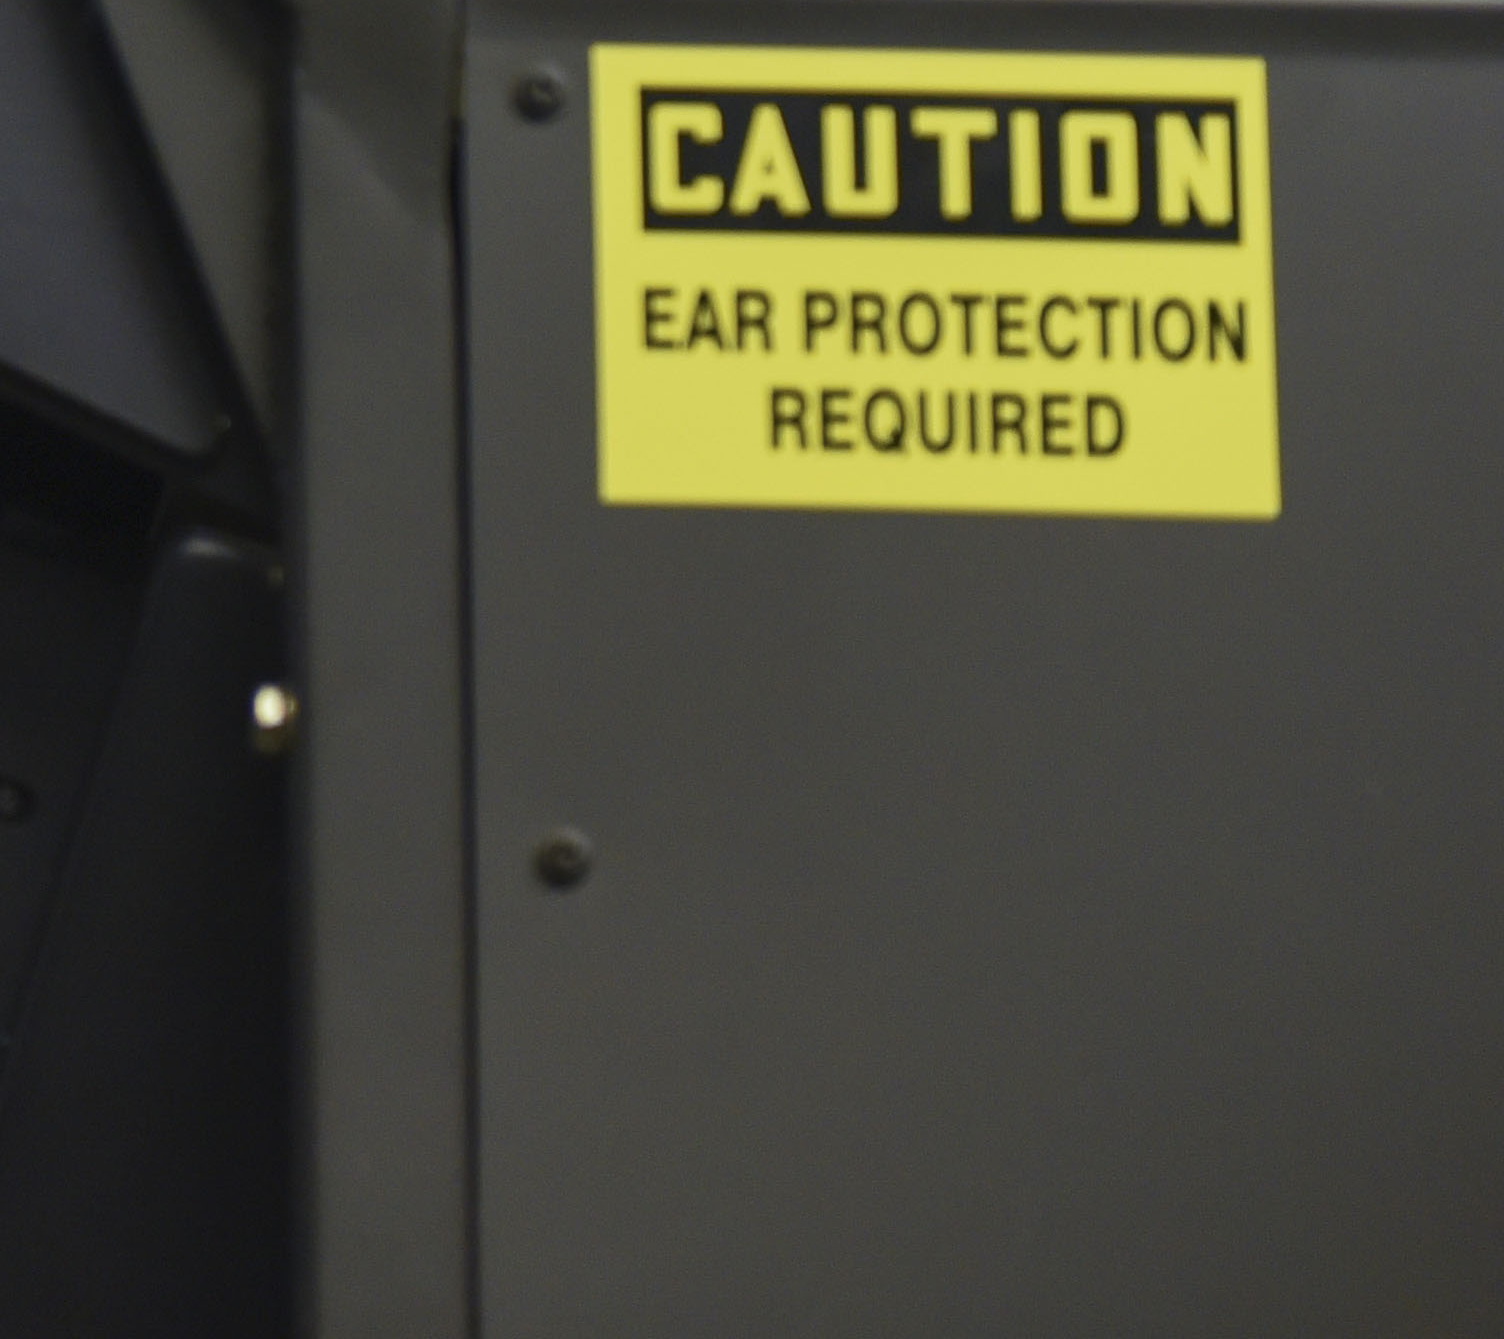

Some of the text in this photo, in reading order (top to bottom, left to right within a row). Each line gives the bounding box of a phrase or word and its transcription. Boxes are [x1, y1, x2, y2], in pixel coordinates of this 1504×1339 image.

[647, 101, 1234, 226] CAUTION
[642, 286, 1247, 364] EAR PROTECTION
[769, 387, 1127, 458] REQUIRED
